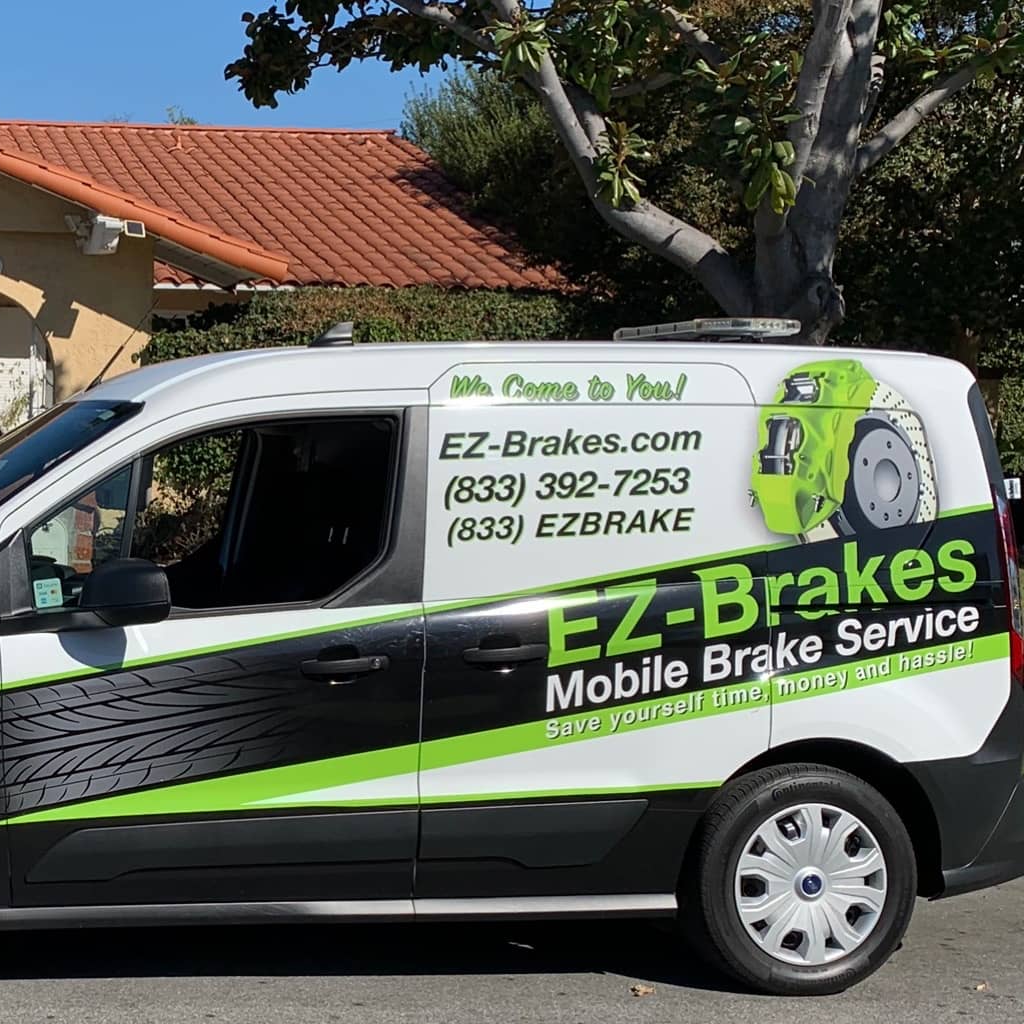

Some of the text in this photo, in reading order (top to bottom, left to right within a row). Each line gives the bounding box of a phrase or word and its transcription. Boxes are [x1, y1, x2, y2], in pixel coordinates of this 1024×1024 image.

[450, 372, 688, 401] We Come to You!
[439, 428, 702, 460] EZ-Brakes.com
[444, 467, 691, 510] (833) 392-7253
[447, 507, 695, 547] (833) EZBRAKE
[547, 539, 977, 668] EZ-Brakes
[545, 605, 979, 713] Mobile Brake Service
[545, 640, 975, 740] Save yourself time, money and hassle!
